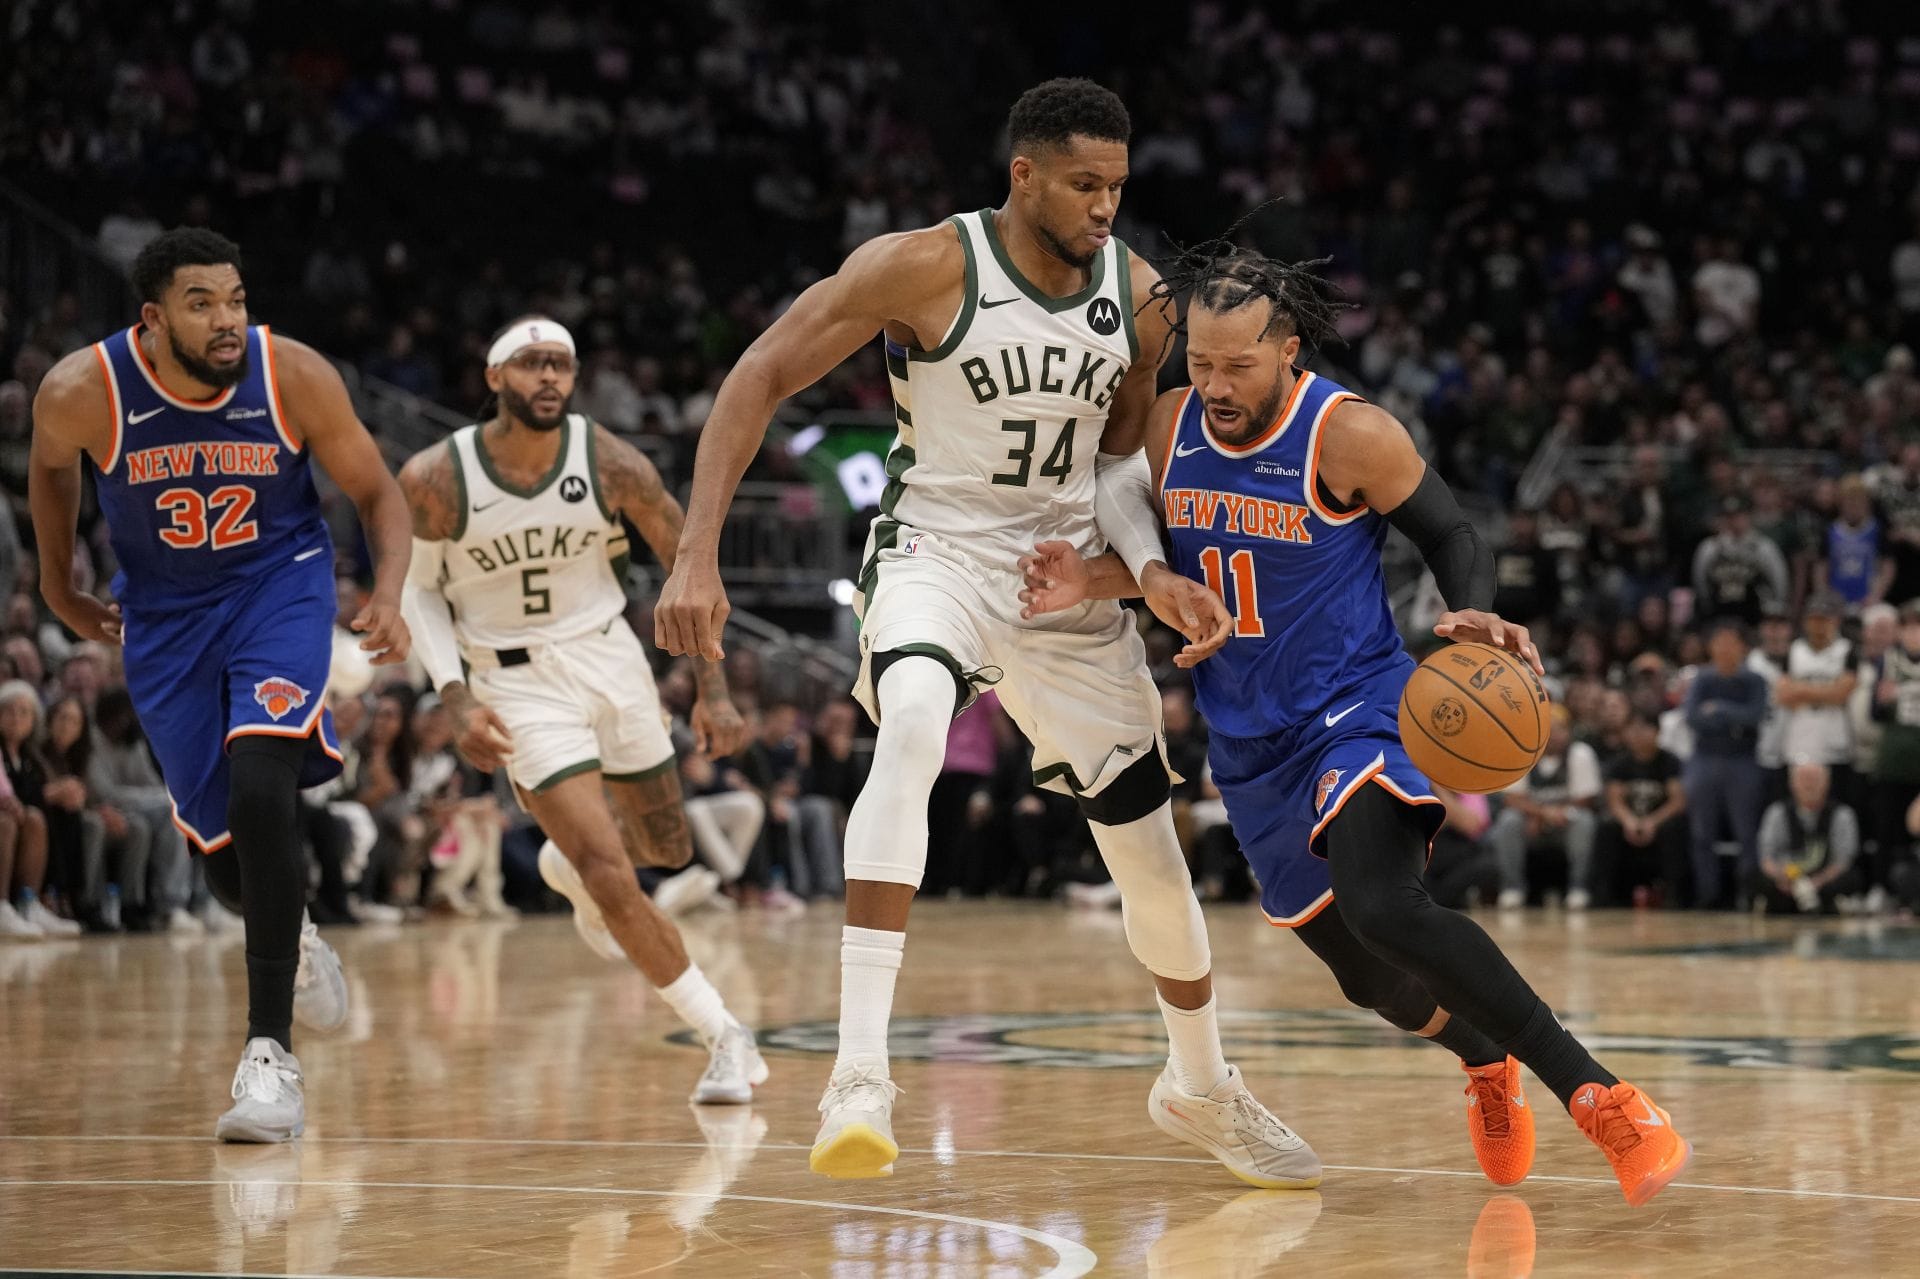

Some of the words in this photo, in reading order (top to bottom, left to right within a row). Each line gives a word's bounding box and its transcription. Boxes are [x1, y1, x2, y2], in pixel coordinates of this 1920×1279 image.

[959, 345, 1125, 410] BUCKS
[125, 442, 197, 485] NEW
[199, 441, 280, 476] YORK
[991, 417, 1078, 488] 34
[1254, 465, 1272, 474] abu
[1273, 466, 1301, 477] dhabi
[155, 484, 259, 551] 32
[1163, 488, 1220, 530] NEW
[1221, 493, 1313, 544] YORK
[521, 567, 551, 616] 5
[1199, 546, 1266, 638] 11
